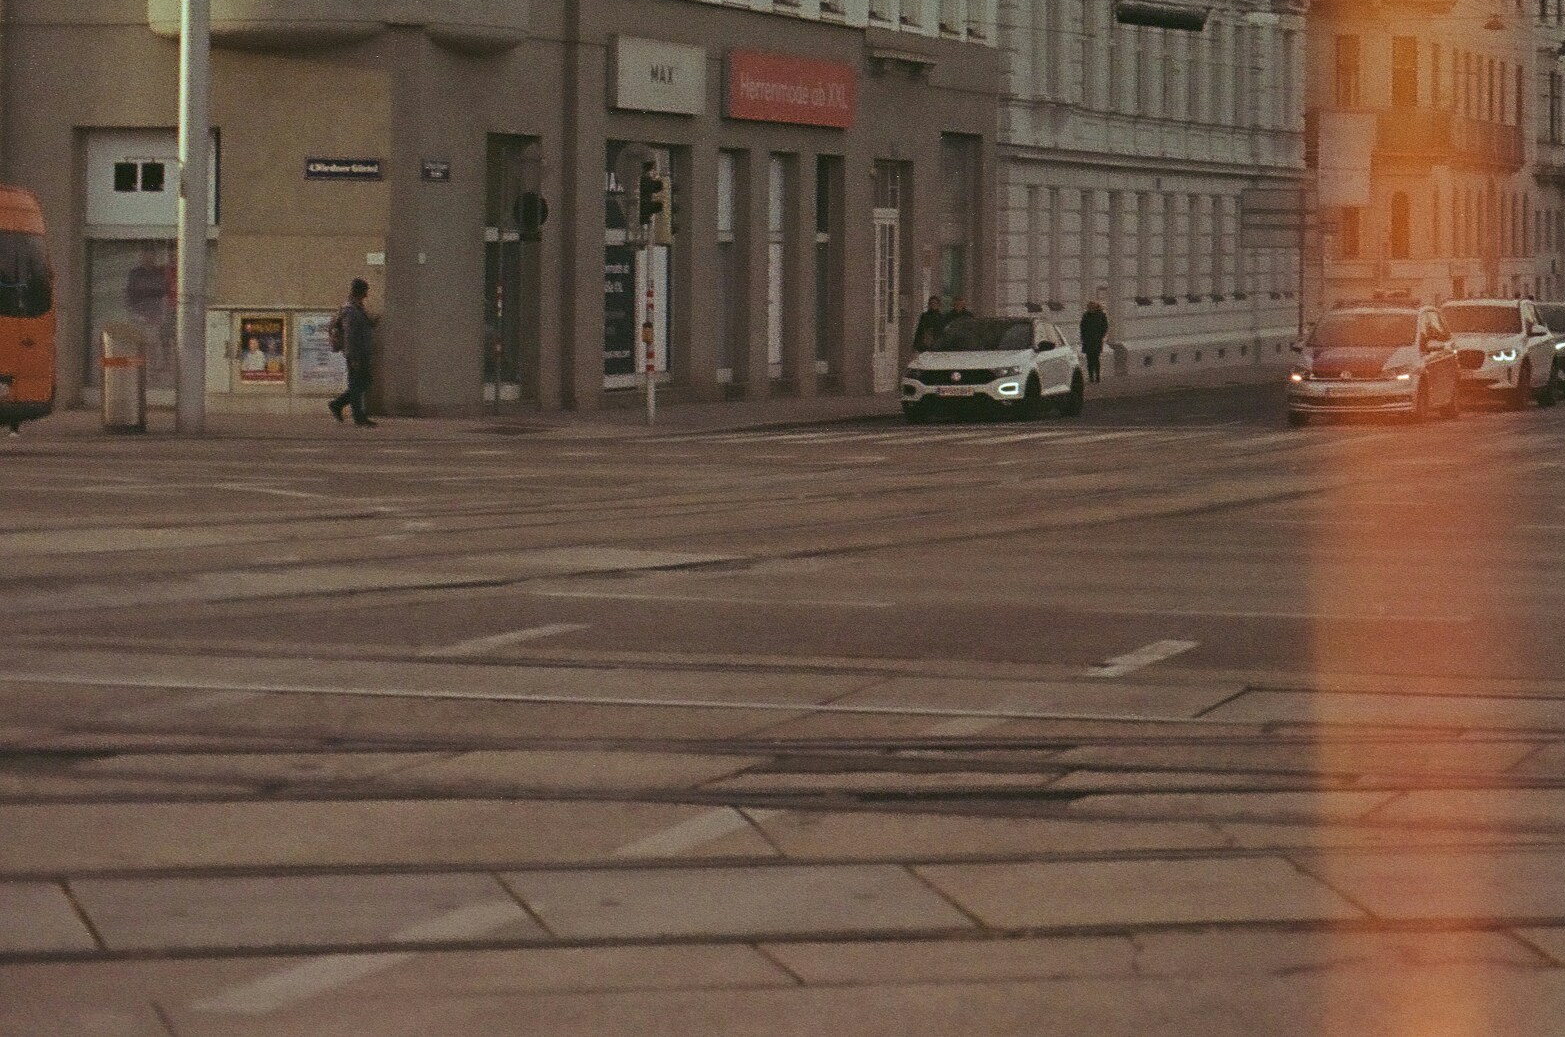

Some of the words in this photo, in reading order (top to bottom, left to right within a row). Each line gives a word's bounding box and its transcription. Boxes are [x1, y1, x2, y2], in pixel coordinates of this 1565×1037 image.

[650, 64, 674, 85] MAX
[739, 71, 809, 105] Herrenmode
[828, 81, 848, 109] XXL
